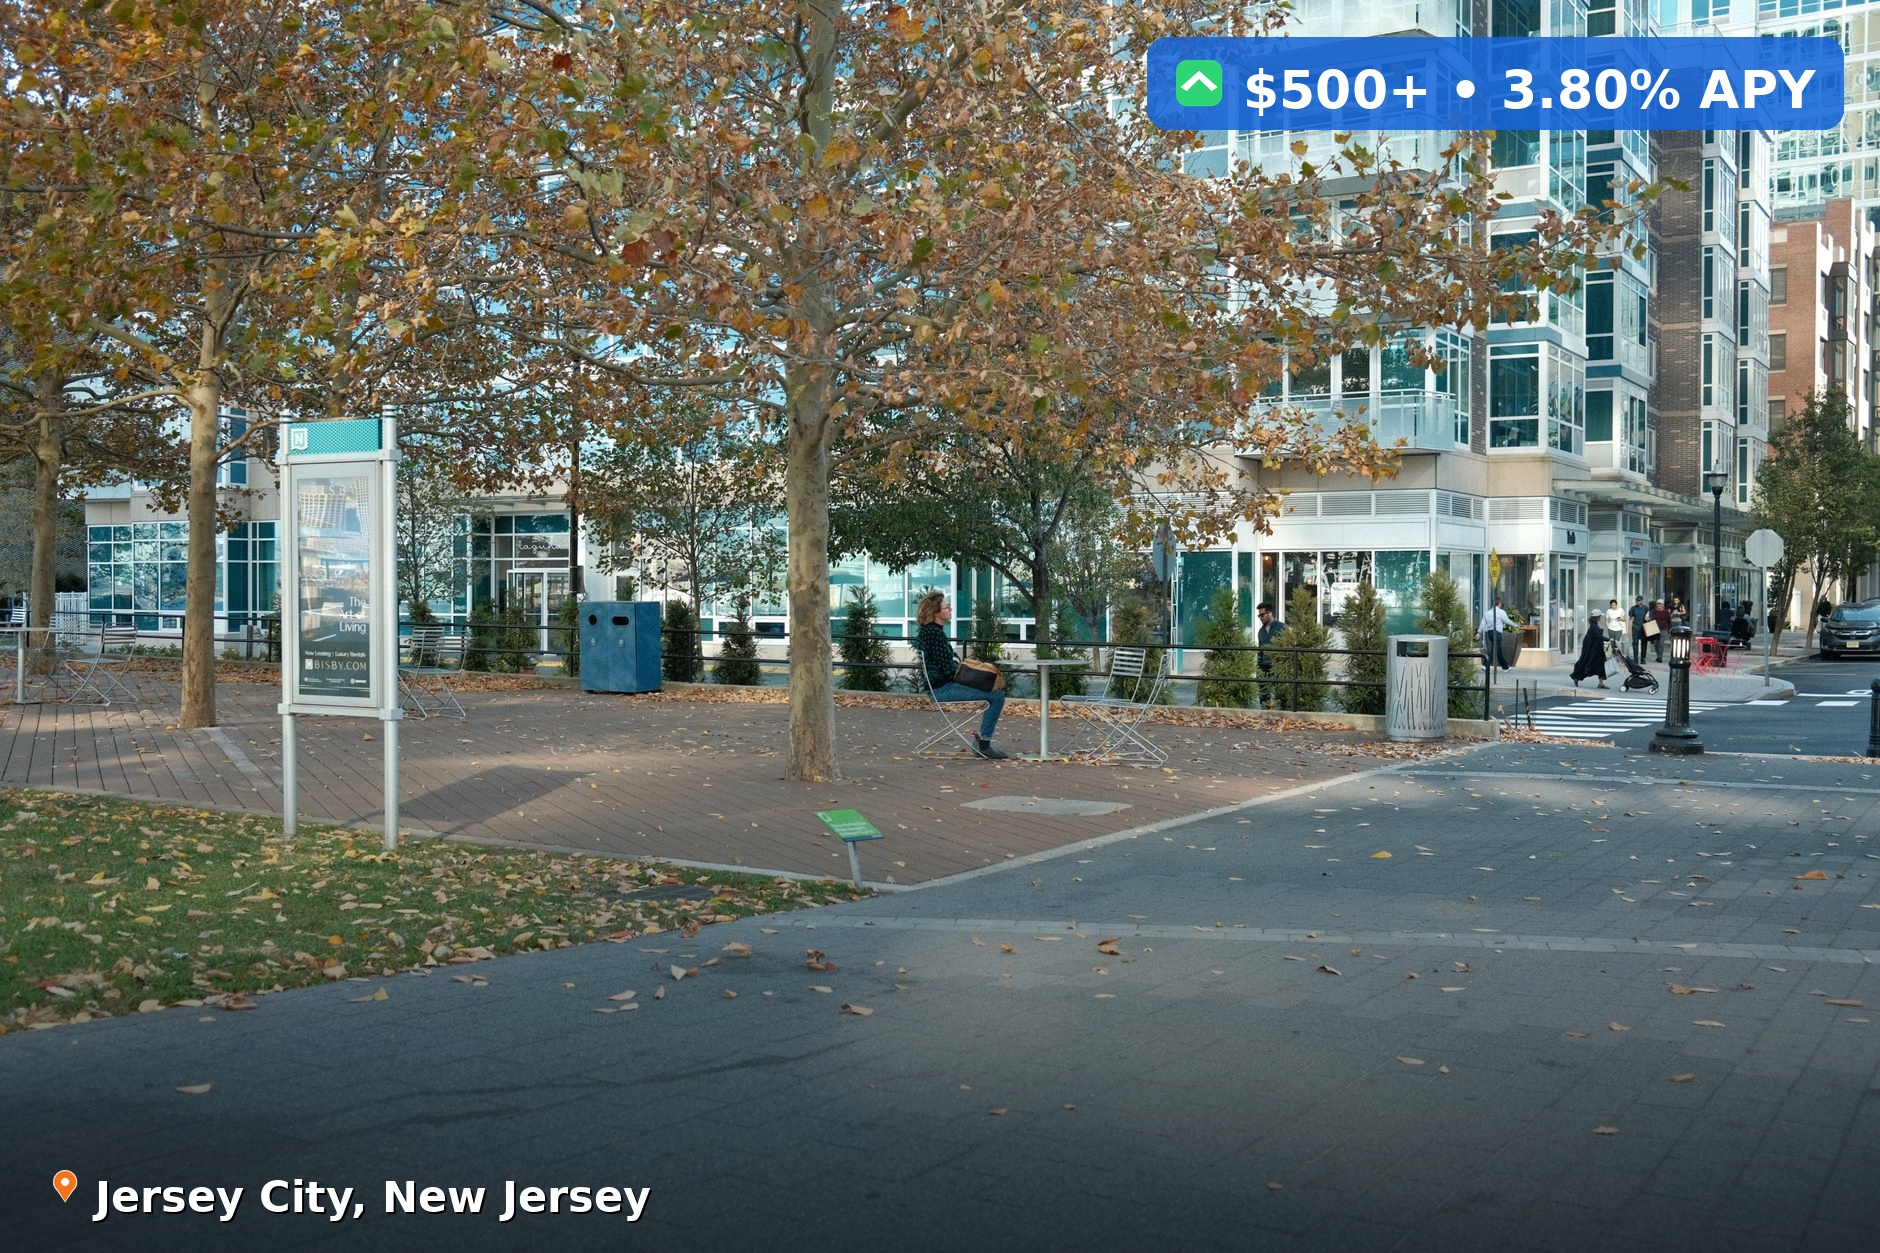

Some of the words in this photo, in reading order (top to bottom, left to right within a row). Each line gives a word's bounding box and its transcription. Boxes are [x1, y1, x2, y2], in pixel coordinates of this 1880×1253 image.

[349, 596, 366, 607] The
[340, 621, 367, 635] Living
[314, 660, 367, 671] BISBY.COM
